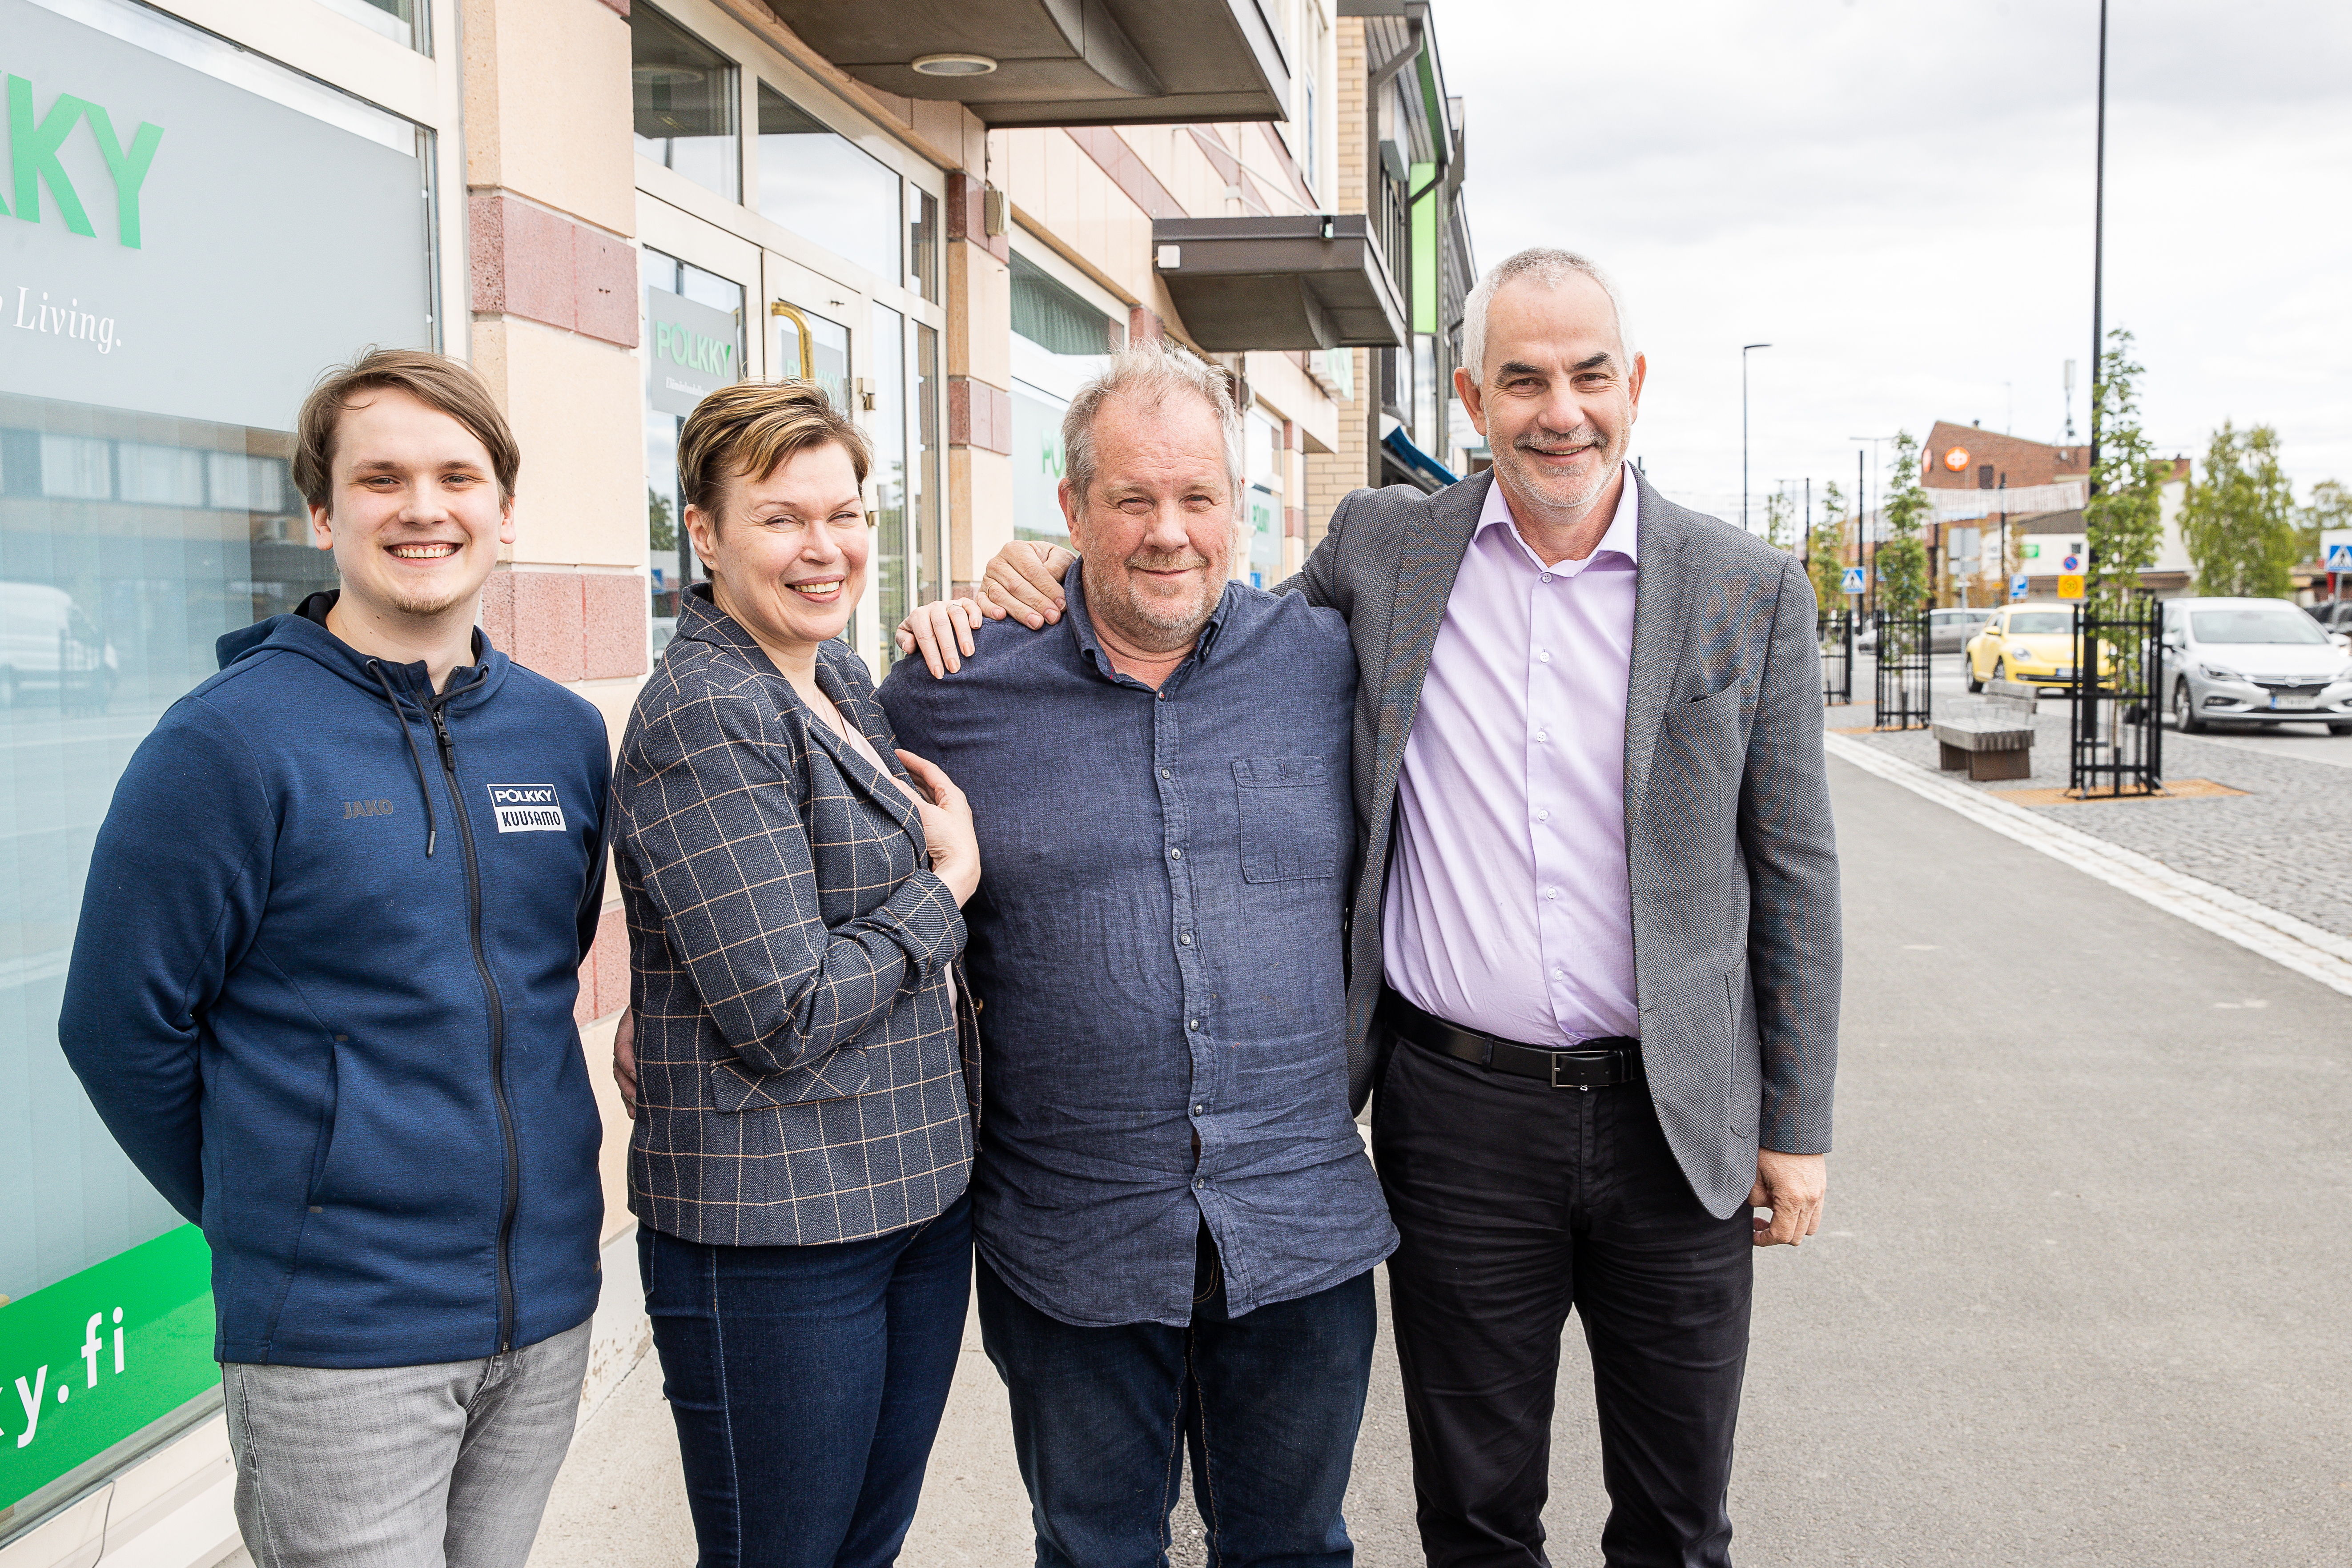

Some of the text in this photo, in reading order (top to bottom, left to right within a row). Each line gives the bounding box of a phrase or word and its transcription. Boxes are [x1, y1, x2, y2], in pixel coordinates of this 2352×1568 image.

[0, 70, 165, 250] KY
[12, 285, 121, 354] Living.
[343, 799, 394, 820] JAKO
[502, 811, 561, 827] KUUSAMO
[0, 1307, 125, 1448] y.fi
